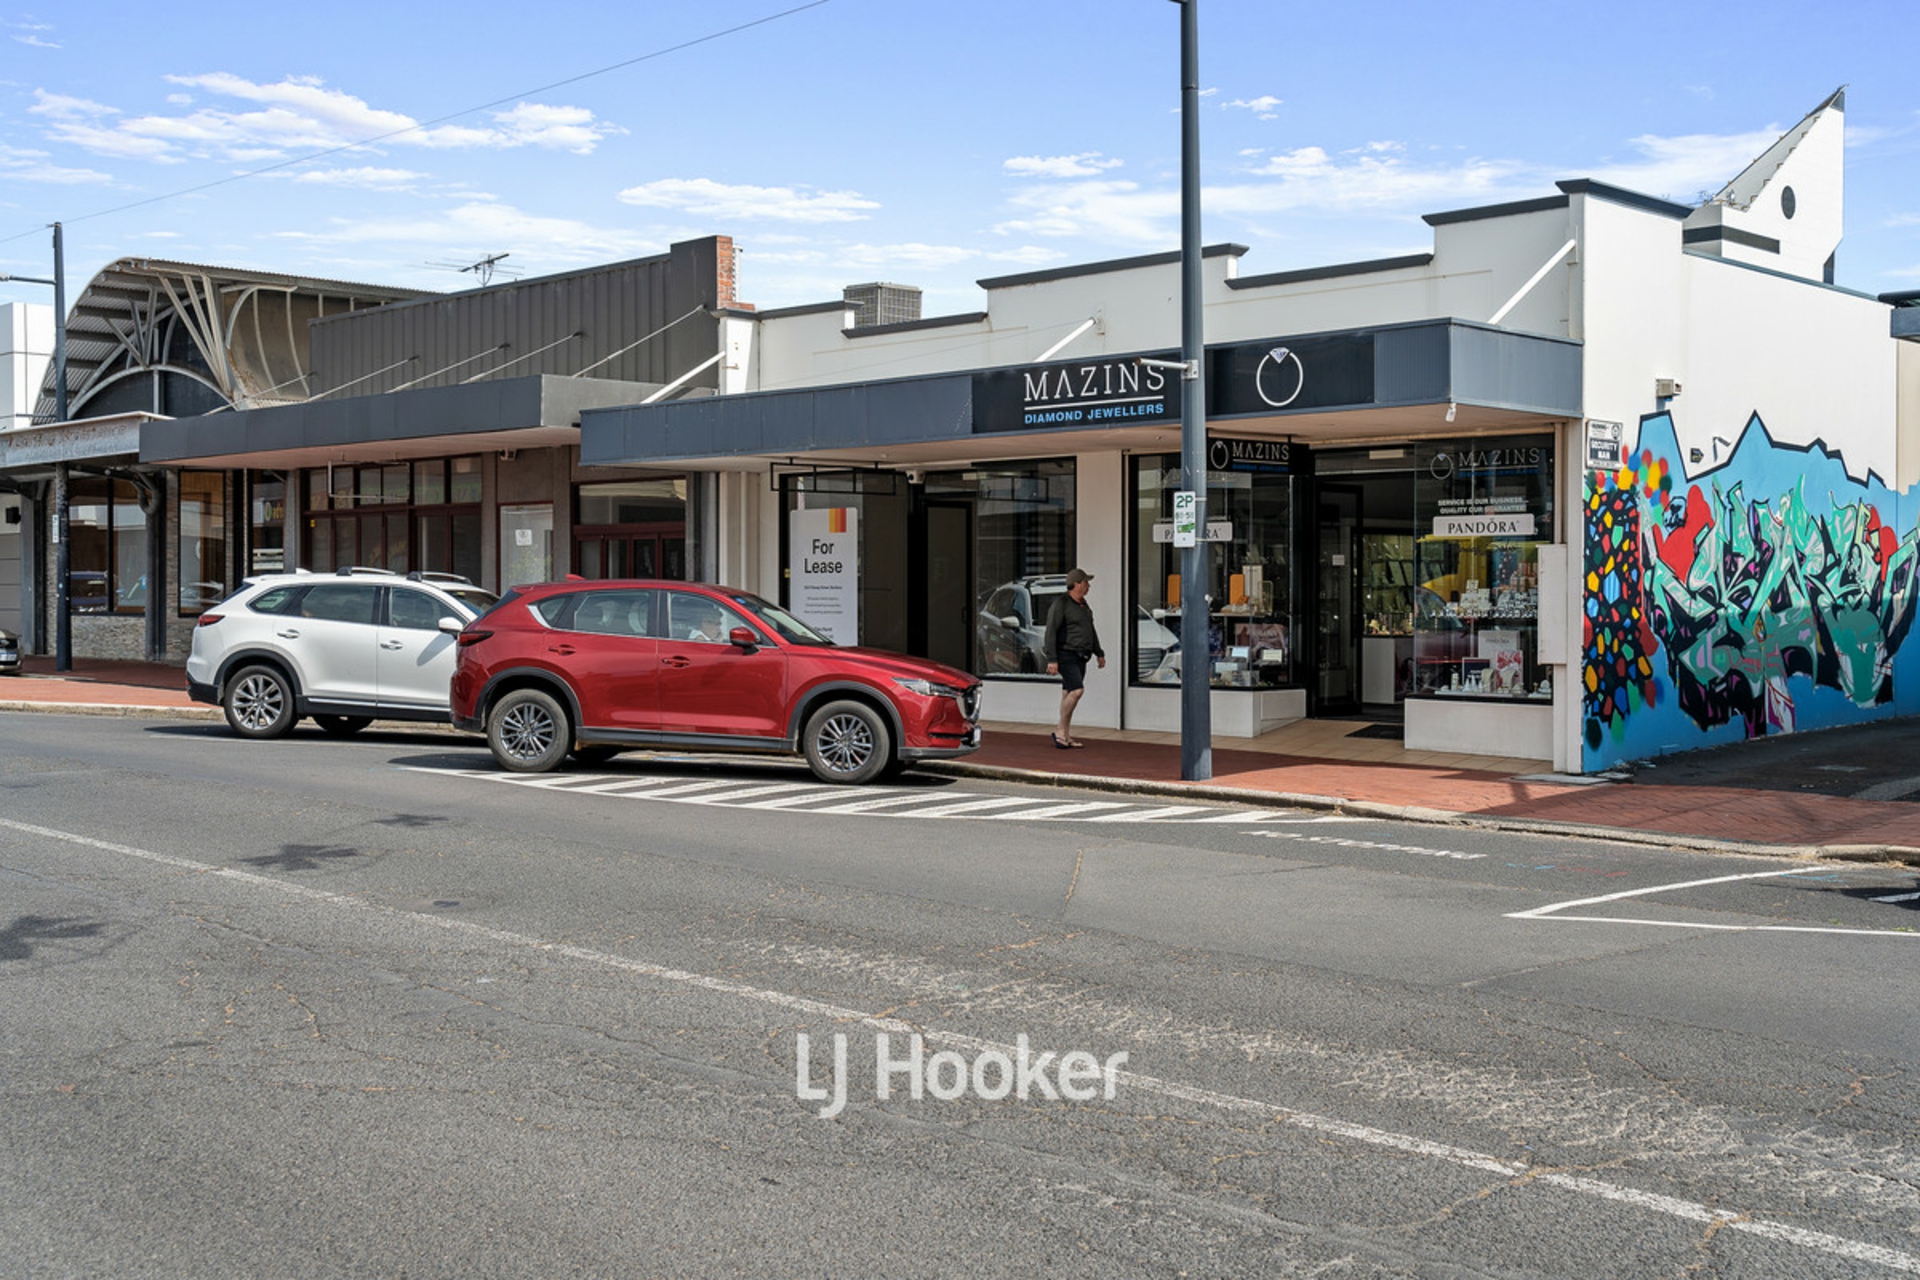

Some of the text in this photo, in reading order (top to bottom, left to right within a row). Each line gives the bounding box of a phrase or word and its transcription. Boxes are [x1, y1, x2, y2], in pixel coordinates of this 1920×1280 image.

[1024, 362, 1165, 401] MAZINS
[1025, 403, 1164, 424] DIAMOND JEWELLERS
[1232, 441, 1289, 460] MAZINS
[1458, 448, 1540, 466] MAZINS
[1176, 495, 1194, 508] 2P
[1448, 519, 1517, 534] PANDORA
[812, 539, 834, 554] For
[804, 558, 843, 574] Lease
